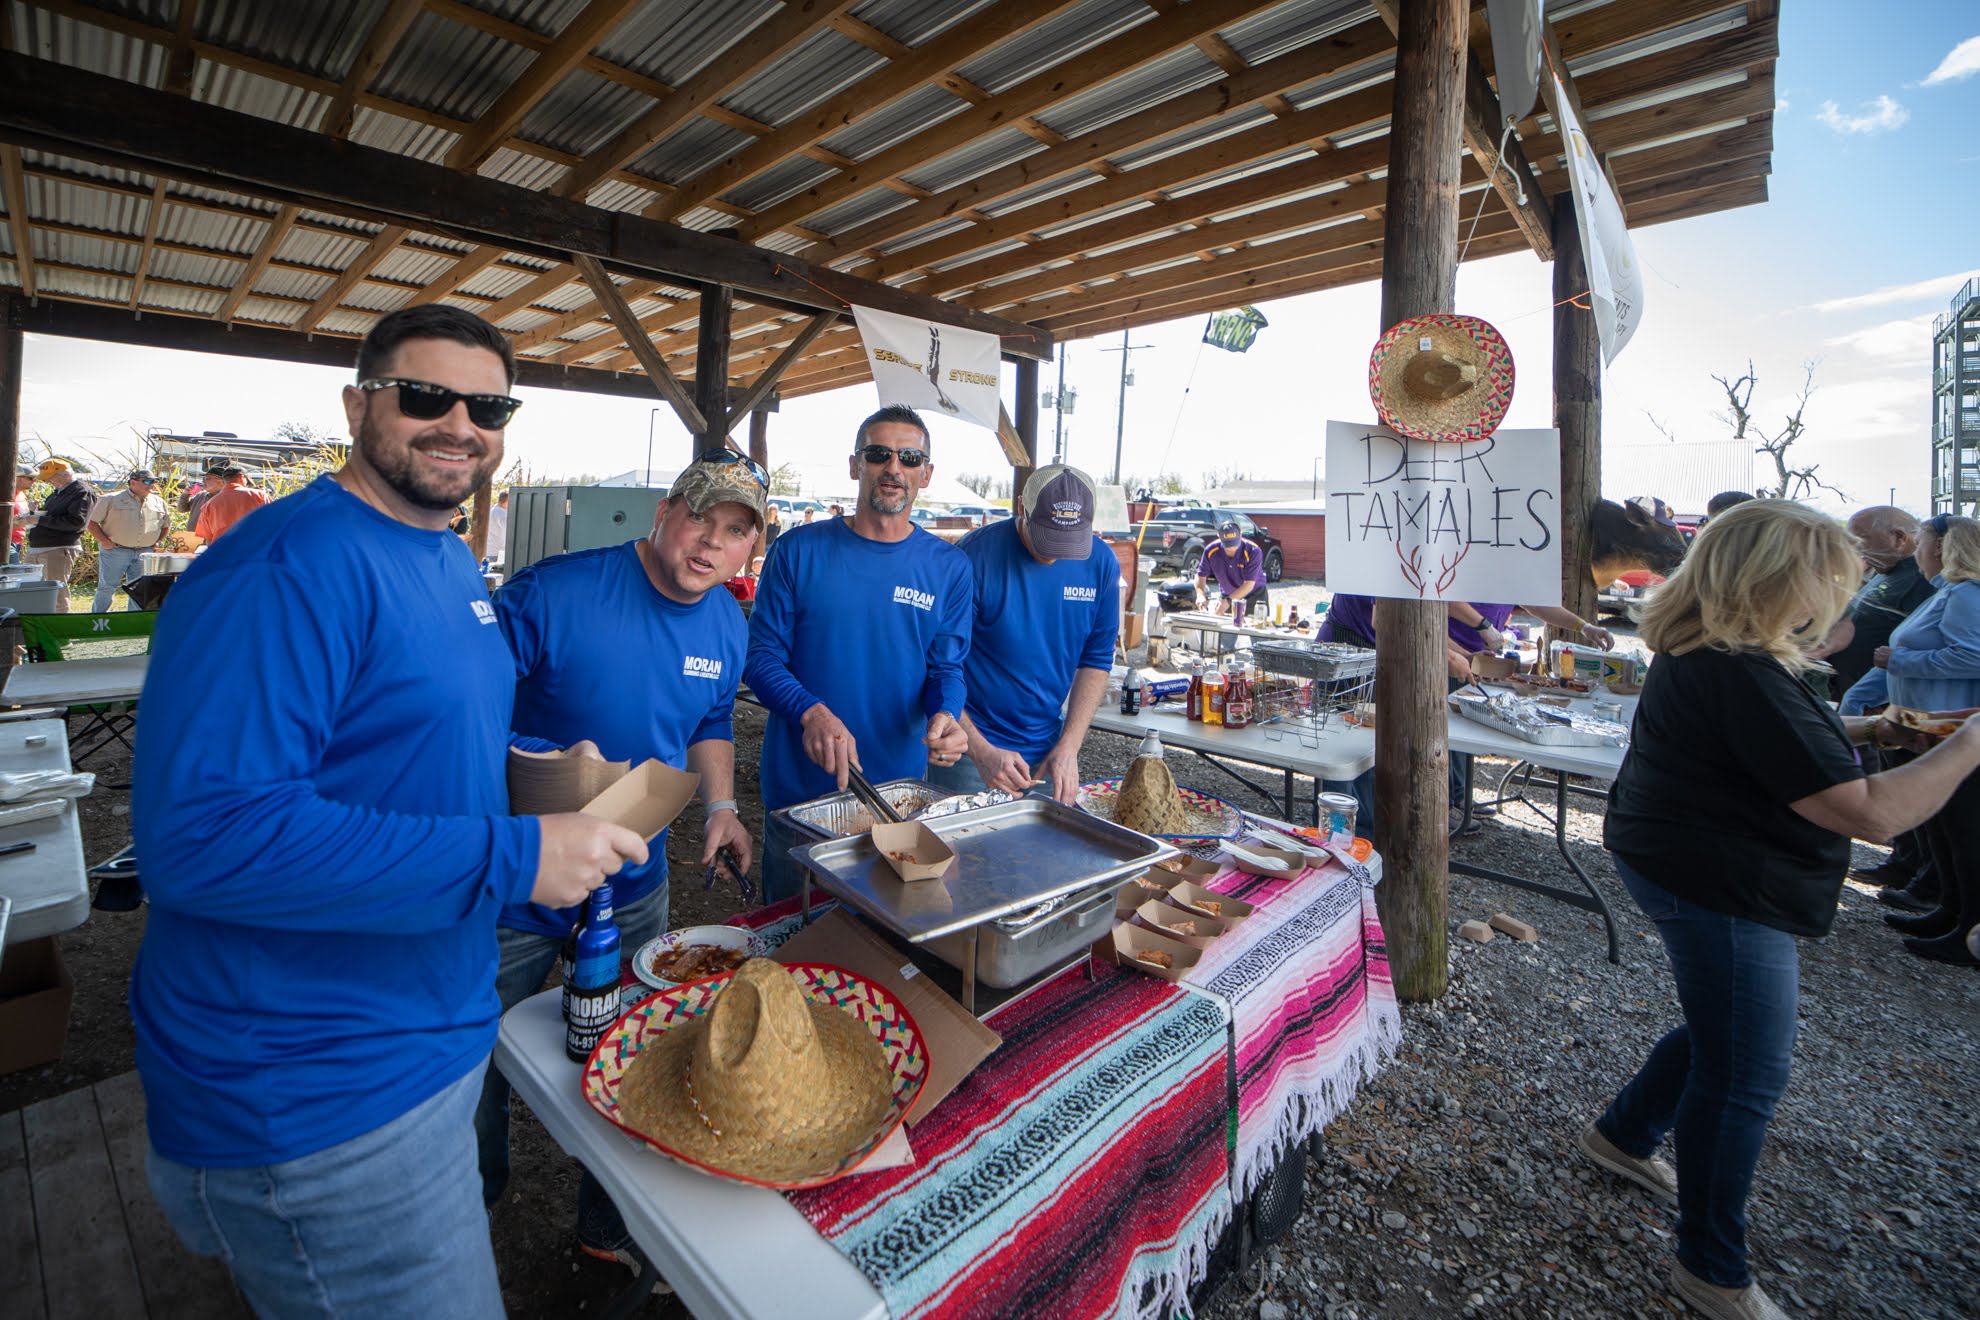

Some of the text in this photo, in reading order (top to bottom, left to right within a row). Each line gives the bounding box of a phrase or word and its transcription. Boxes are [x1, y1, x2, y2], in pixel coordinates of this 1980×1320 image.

[949, 368, 998, 387] STRONG
[1360, 433, 1496, 488] DEER
[1331, 486, 1553, 551] TAMALES
[894, 586, 936, 607] MORAN
[1063, 586, 1097, 598] MORAN
[684, 656, 722, 674] MORAN
[570, 986, 621, 1018] MORAN
